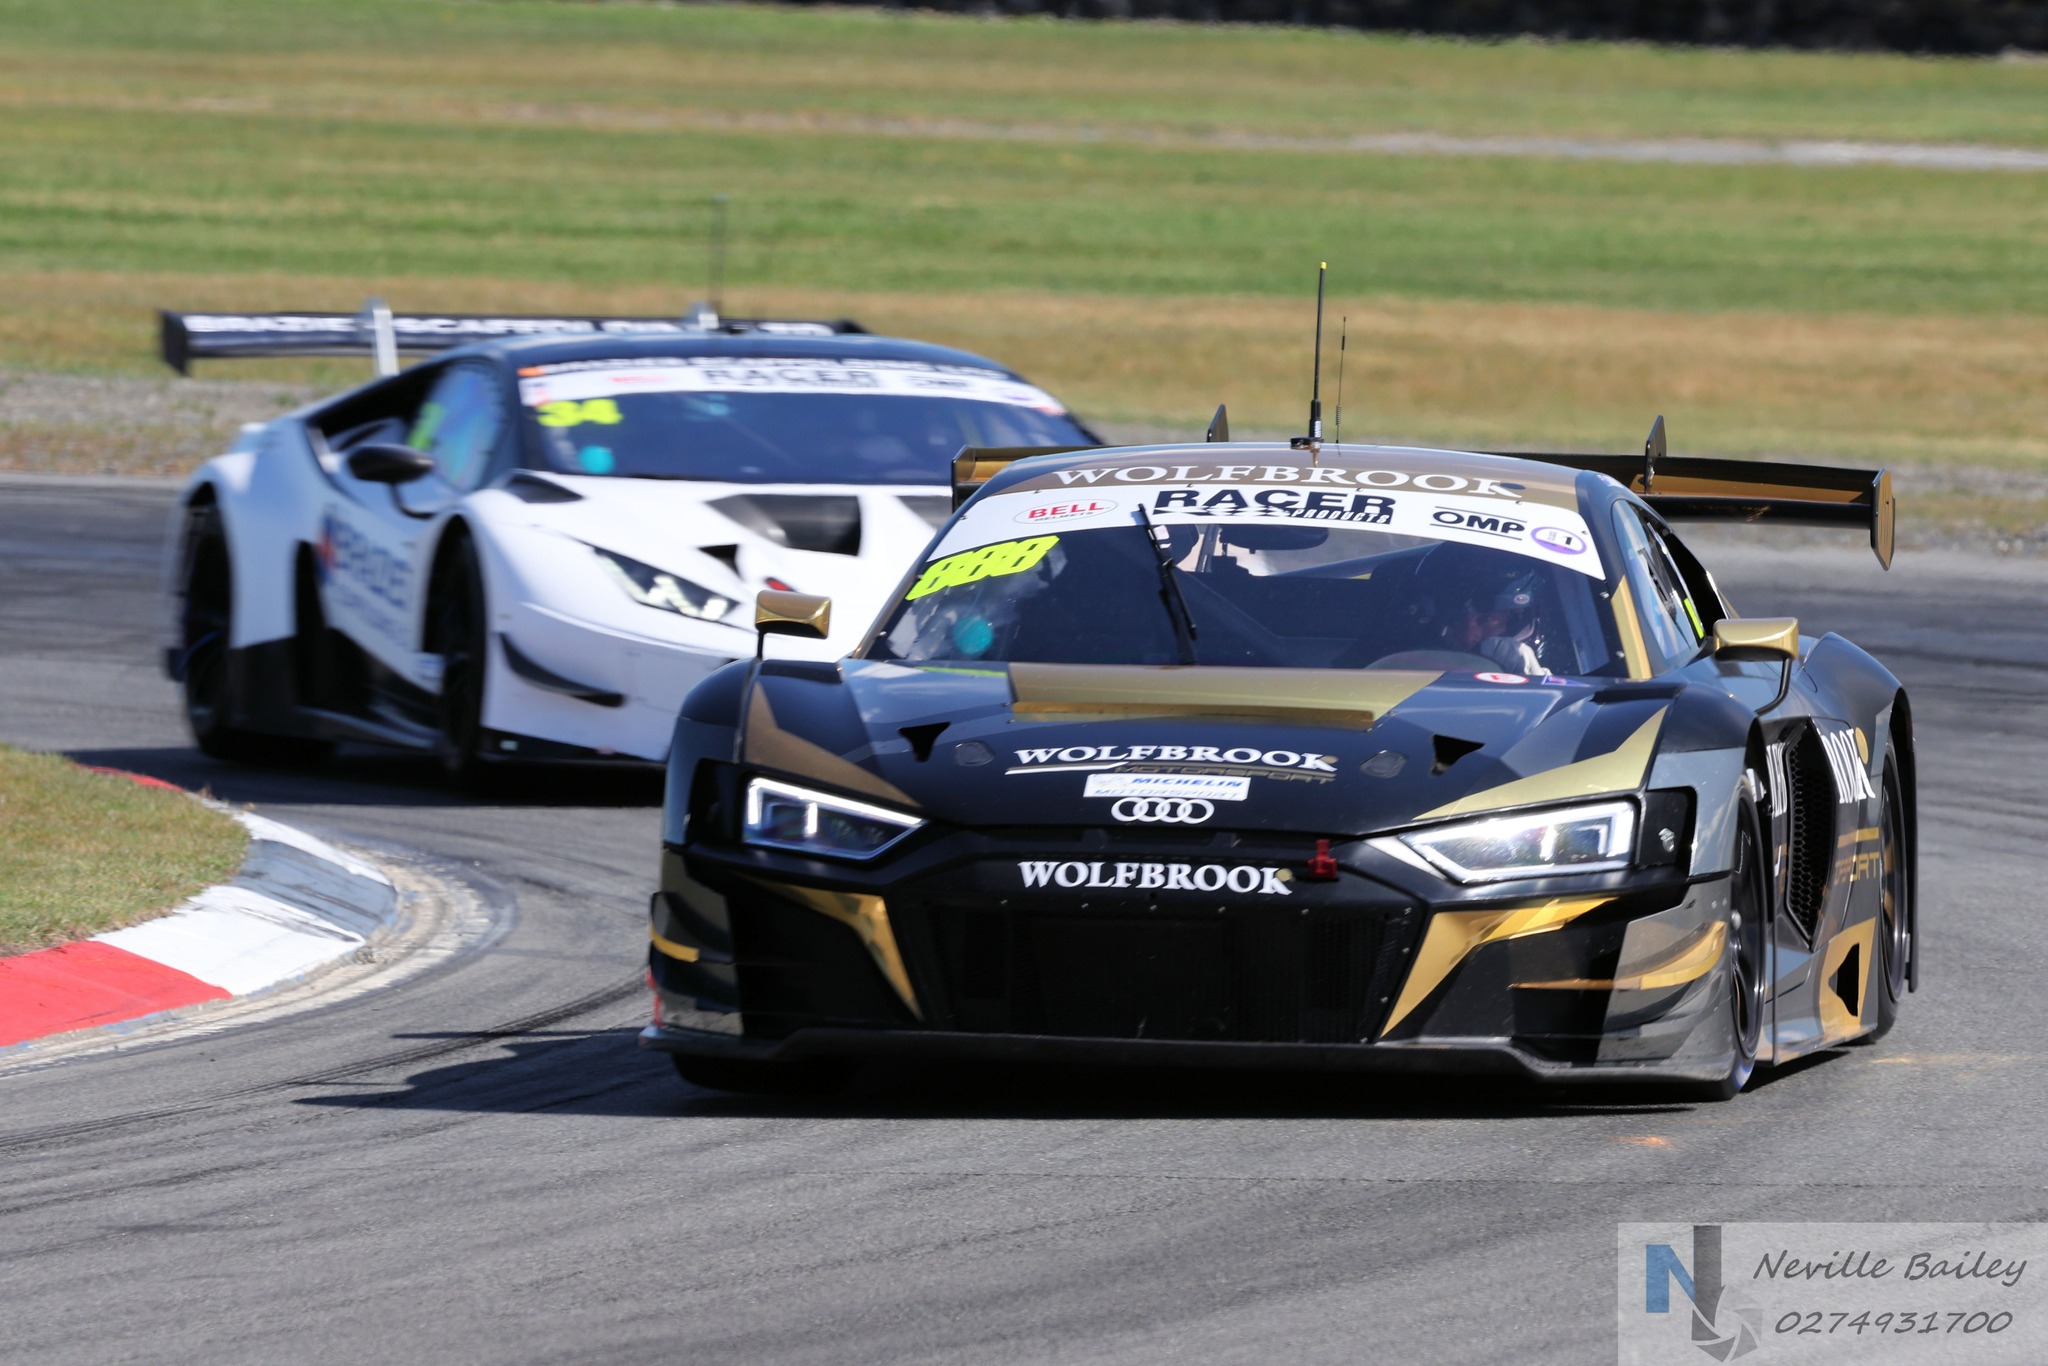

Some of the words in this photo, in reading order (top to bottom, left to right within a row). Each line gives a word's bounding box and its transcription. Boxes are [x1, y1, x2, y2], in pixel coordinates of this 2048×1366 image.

[1052, 465, 1523, 499] WOLFBROOK
[1027, 502, 1105, 519] BELL
[1153, 489, 1396, 522] RACER
[1293, 507, 1391, 524] PRODUCTS
[1432, 510, 1526, 535] OMP
[904, 534, 1061, 602] 888
[1013, 745, 1338, 772] WOLFBROOK
[1131, 776, 1244, 788] MICHELIN
[1017, 861, 1293, 896] WOLFBROOK
